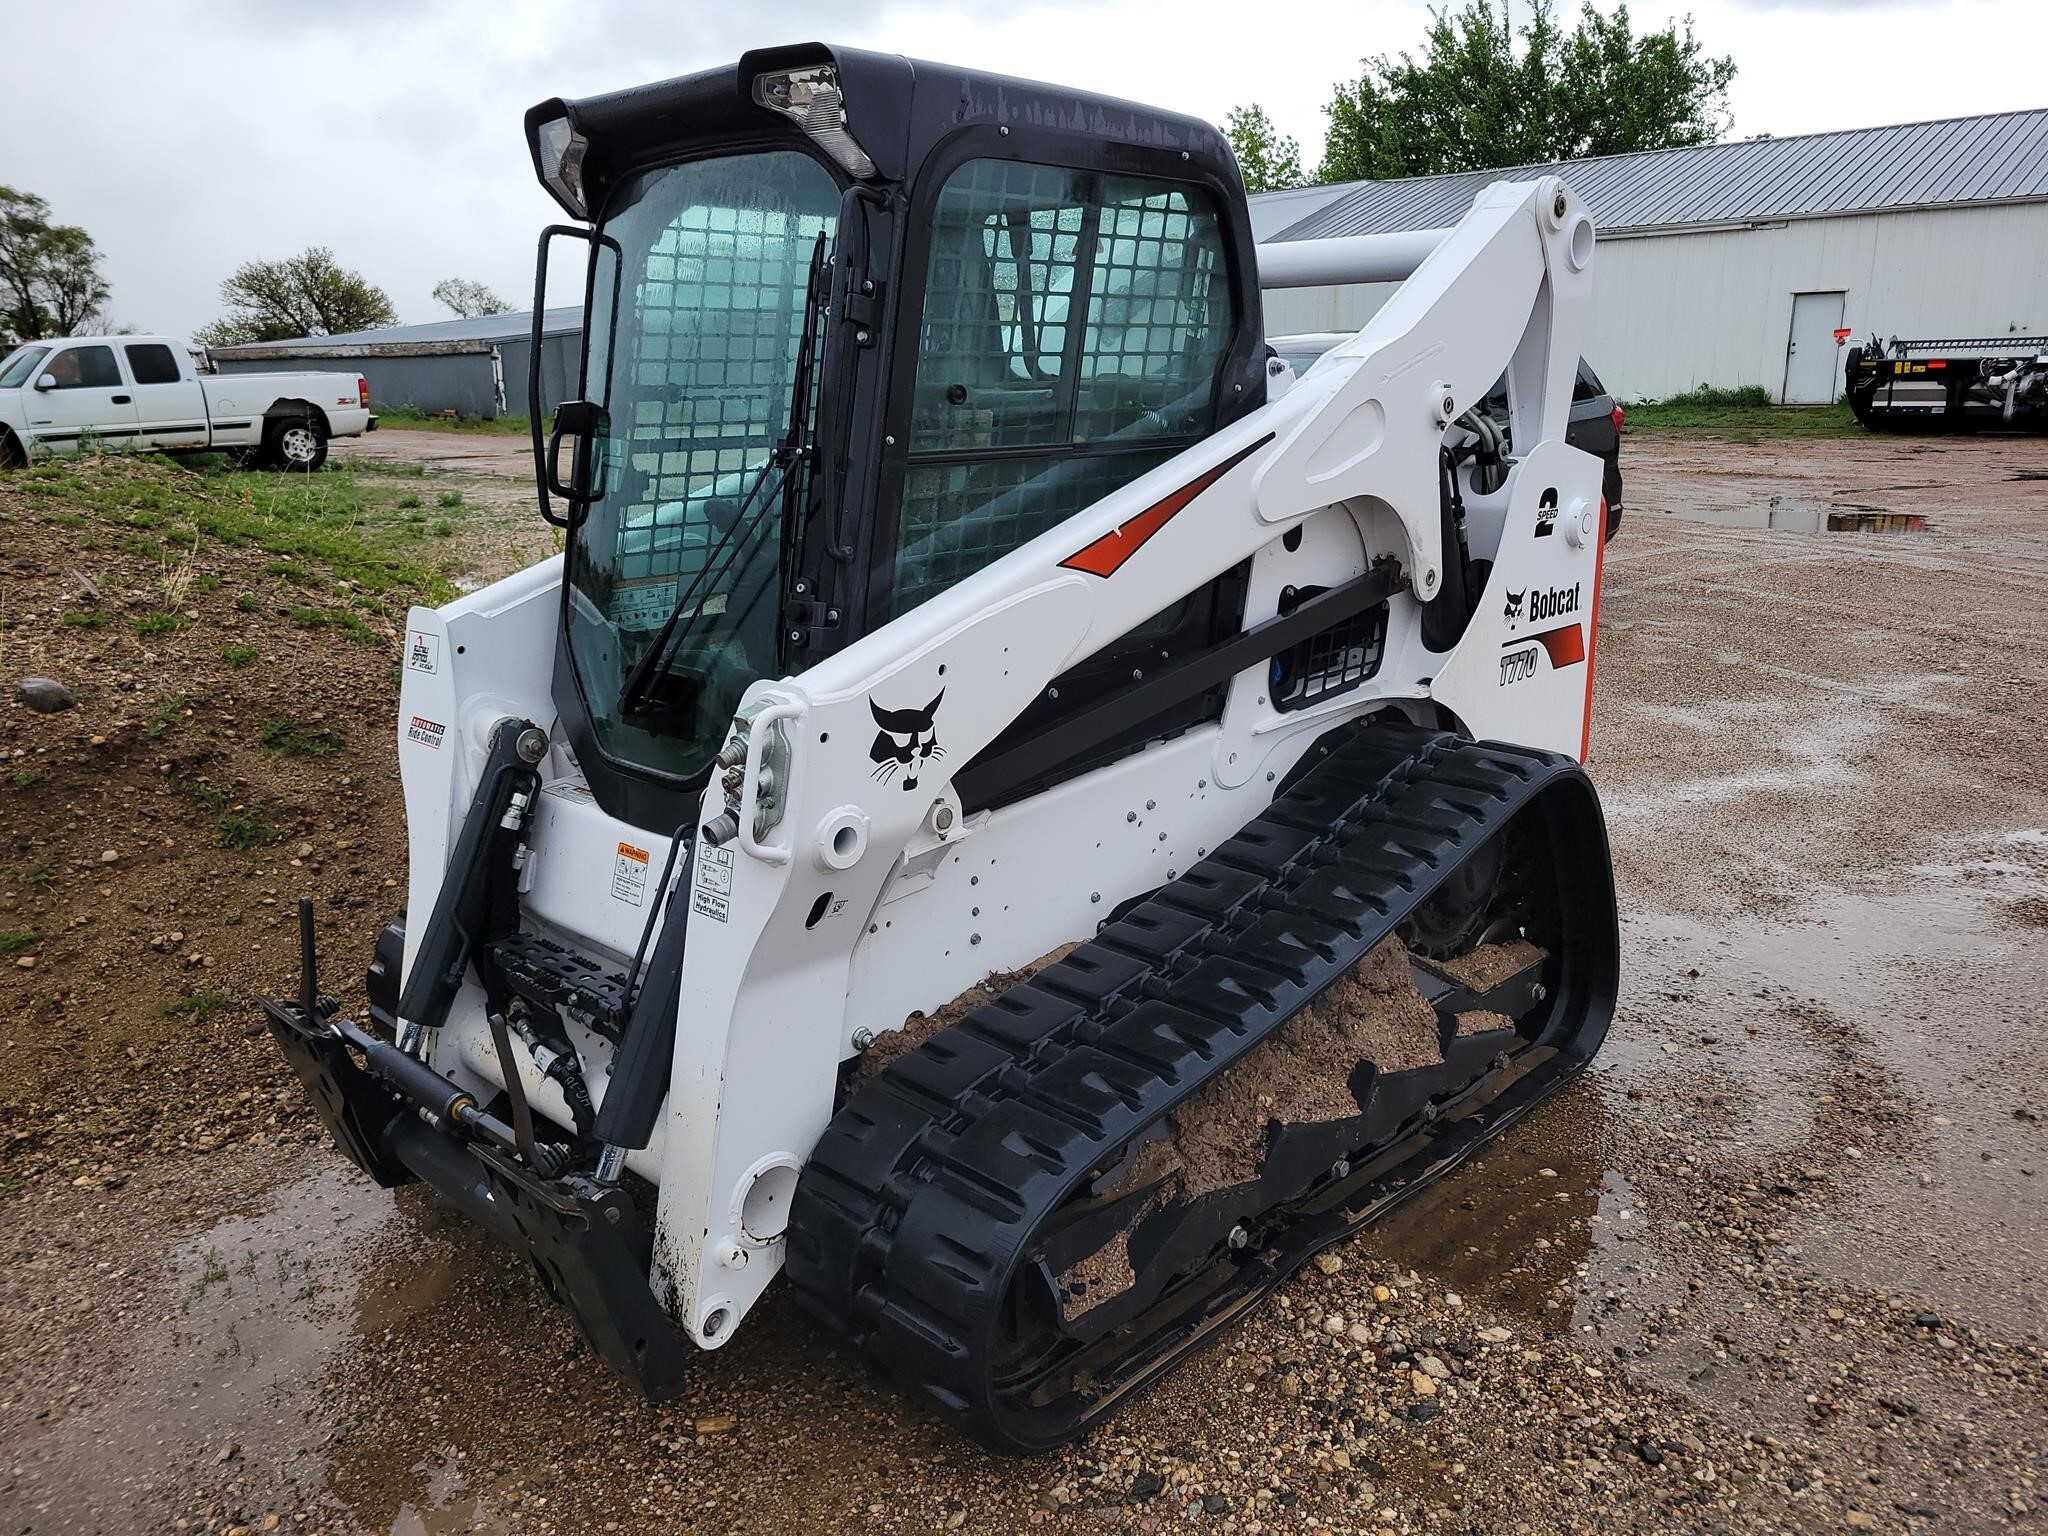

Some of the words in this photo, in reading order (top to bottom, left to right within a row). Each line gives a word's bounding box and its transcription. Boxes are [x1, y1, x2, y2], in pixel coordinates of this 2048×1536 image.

[1534, 487, 1558, 538] 2
[1536, 508, 1559, 521] SPEED
[1529, 582, 1580, 622] Bobcat
[1500, 647, 1538, 687] T770
[412, 718, 444, 735] AUTOMATIC
[408, 727, 421, 740] Ride
[420, 731, 443, 748] Control
[695, 901, 726, 919] Hydraulics
[697, 893, 710, 904] High
[711, 898, 726, 910] Flow
